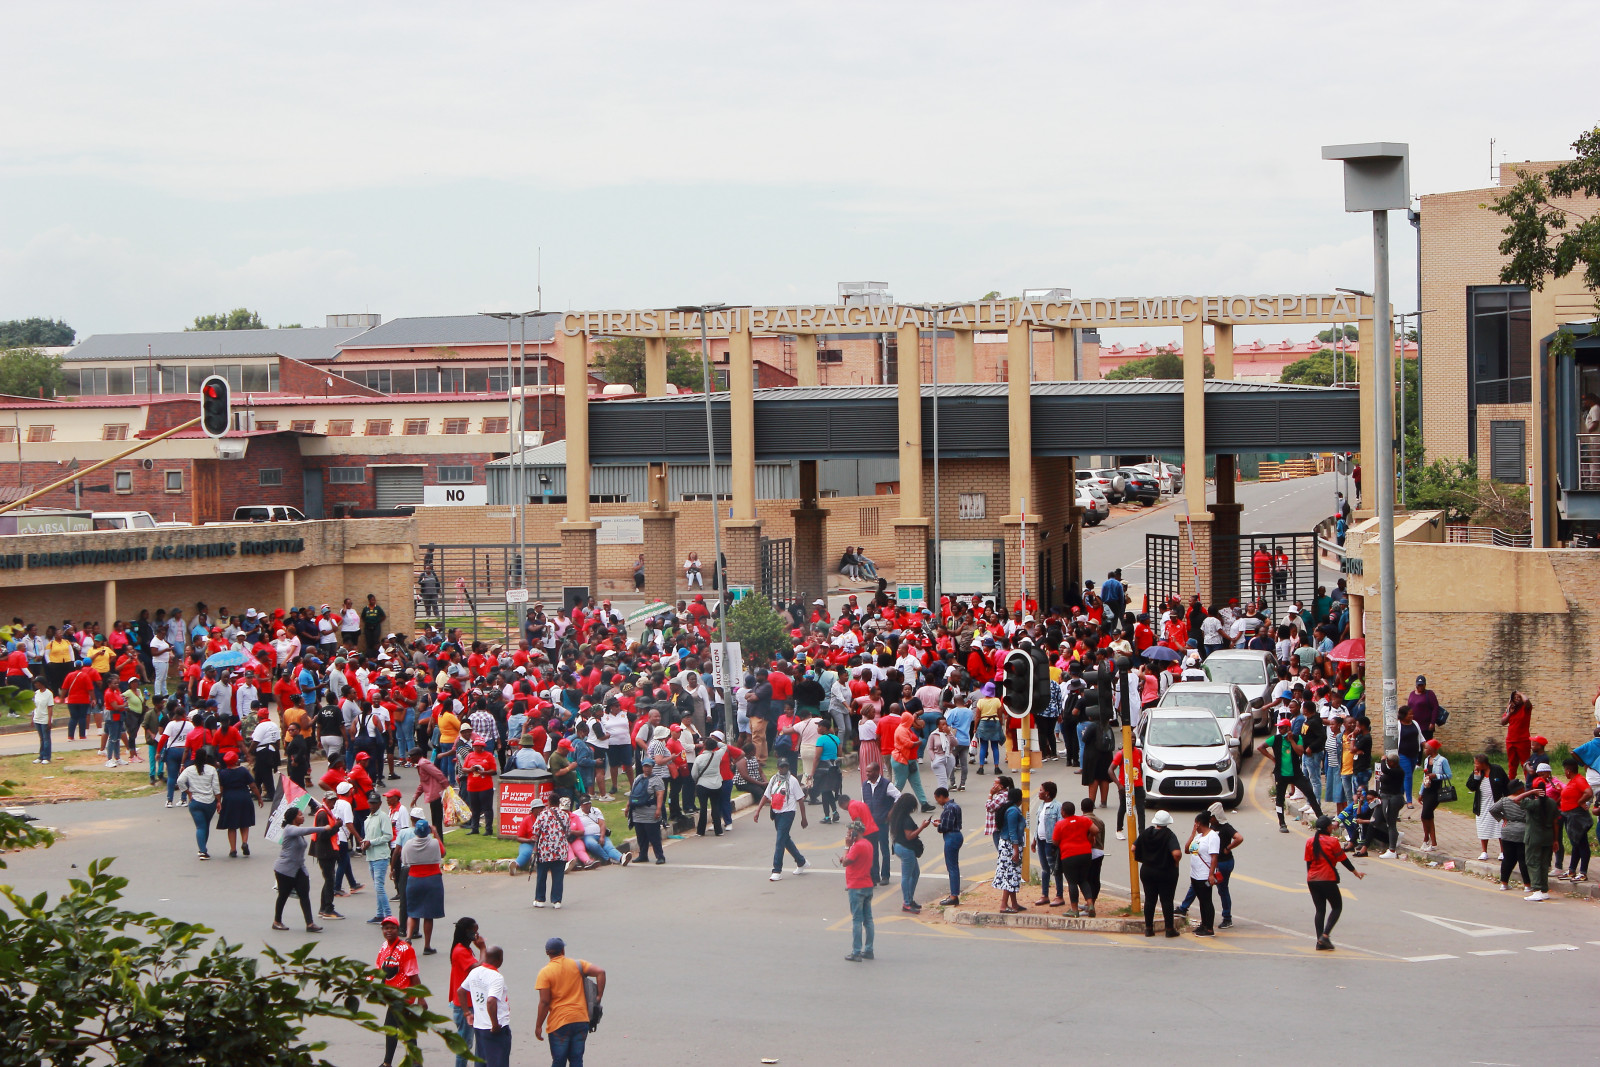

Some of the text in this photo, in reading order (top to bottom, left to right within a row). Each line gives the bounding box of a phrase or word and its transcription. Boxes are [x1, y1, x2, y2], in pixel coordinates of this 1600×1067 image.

[561, 293, 1375, 337] CHRIS HANI BARAGWANATH ACADEMIC HOSPITAL
[446, 489, 465, 502] NO
[37, 523, 89, 534] ABSA ATM
[27, 547, 148, 569] BARAGWANATH
[152, 542, 237, 561] ACADEMIC
[713, 649, 722, 686] AUCTION
